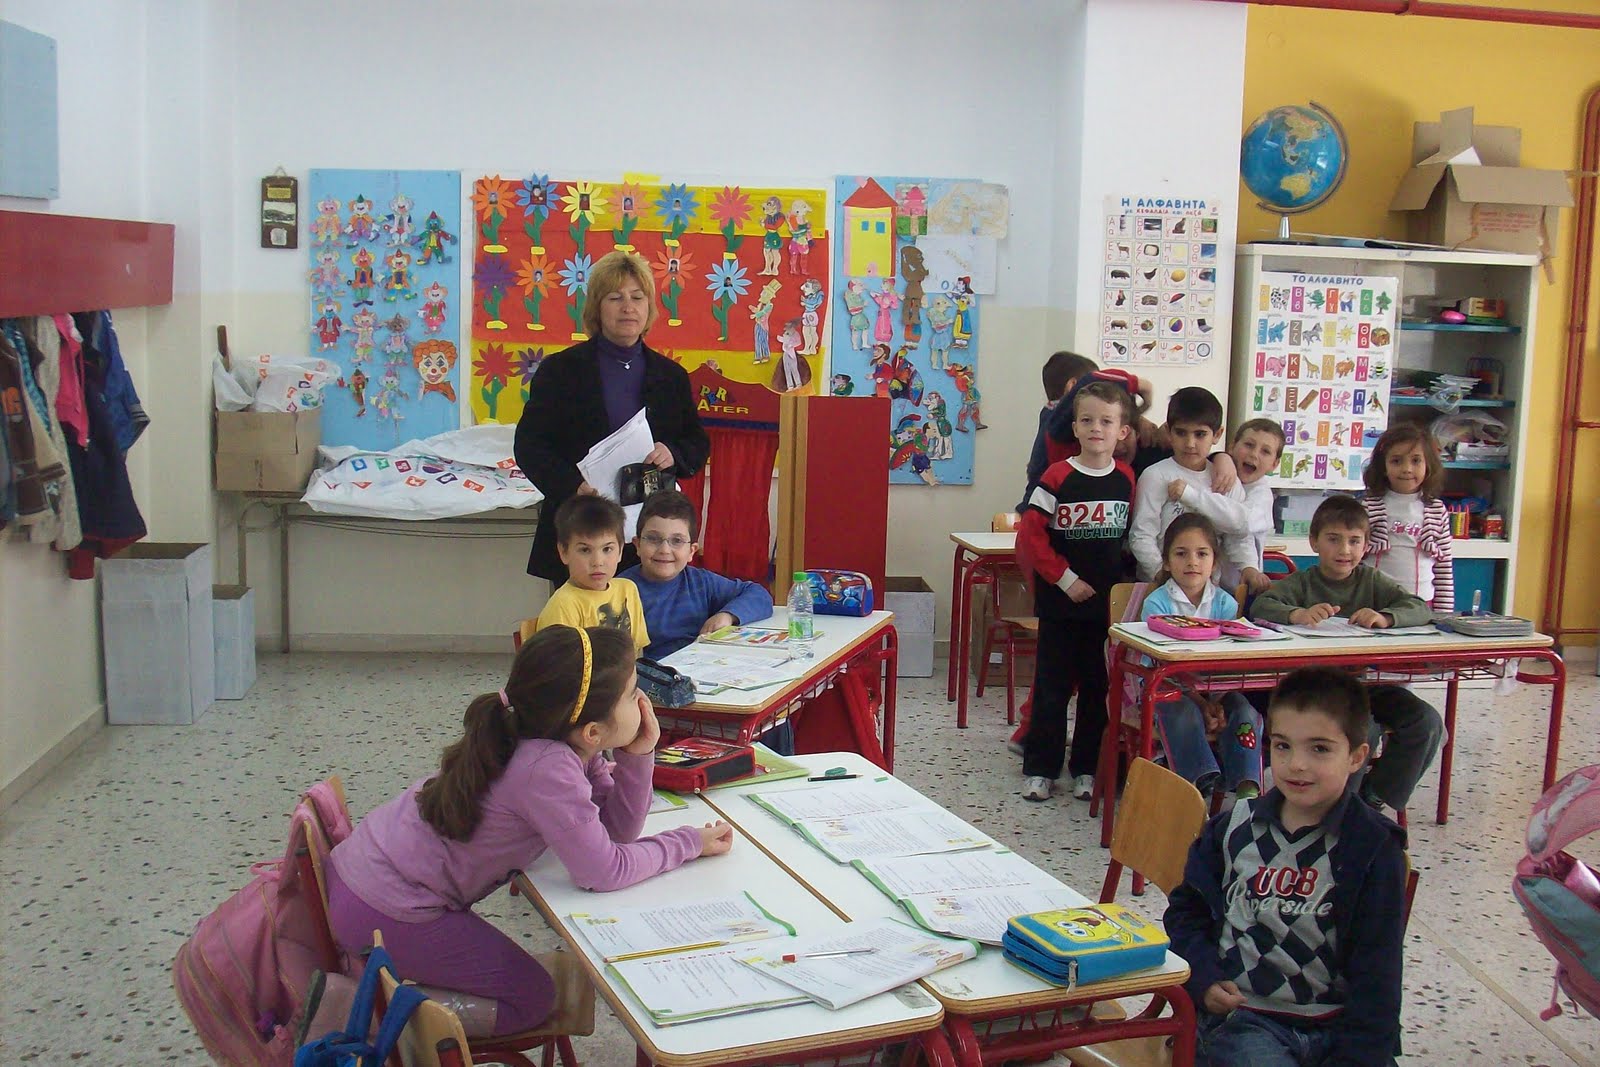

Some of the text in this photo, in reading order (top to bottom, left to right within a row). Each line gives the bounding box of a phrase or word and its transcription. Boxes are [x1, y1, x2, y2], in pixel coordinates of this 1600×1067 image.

[1122, 198, 1206, 209] Η ΑΛΦΑΒΗΤΑ
[1292, 275, 1364, 285] ΤΟ ΑΛΦΑΒΗΤΟ
[1290, 357, 1298, 365] Κ
[1254, 866, 1318, 897] UCB
